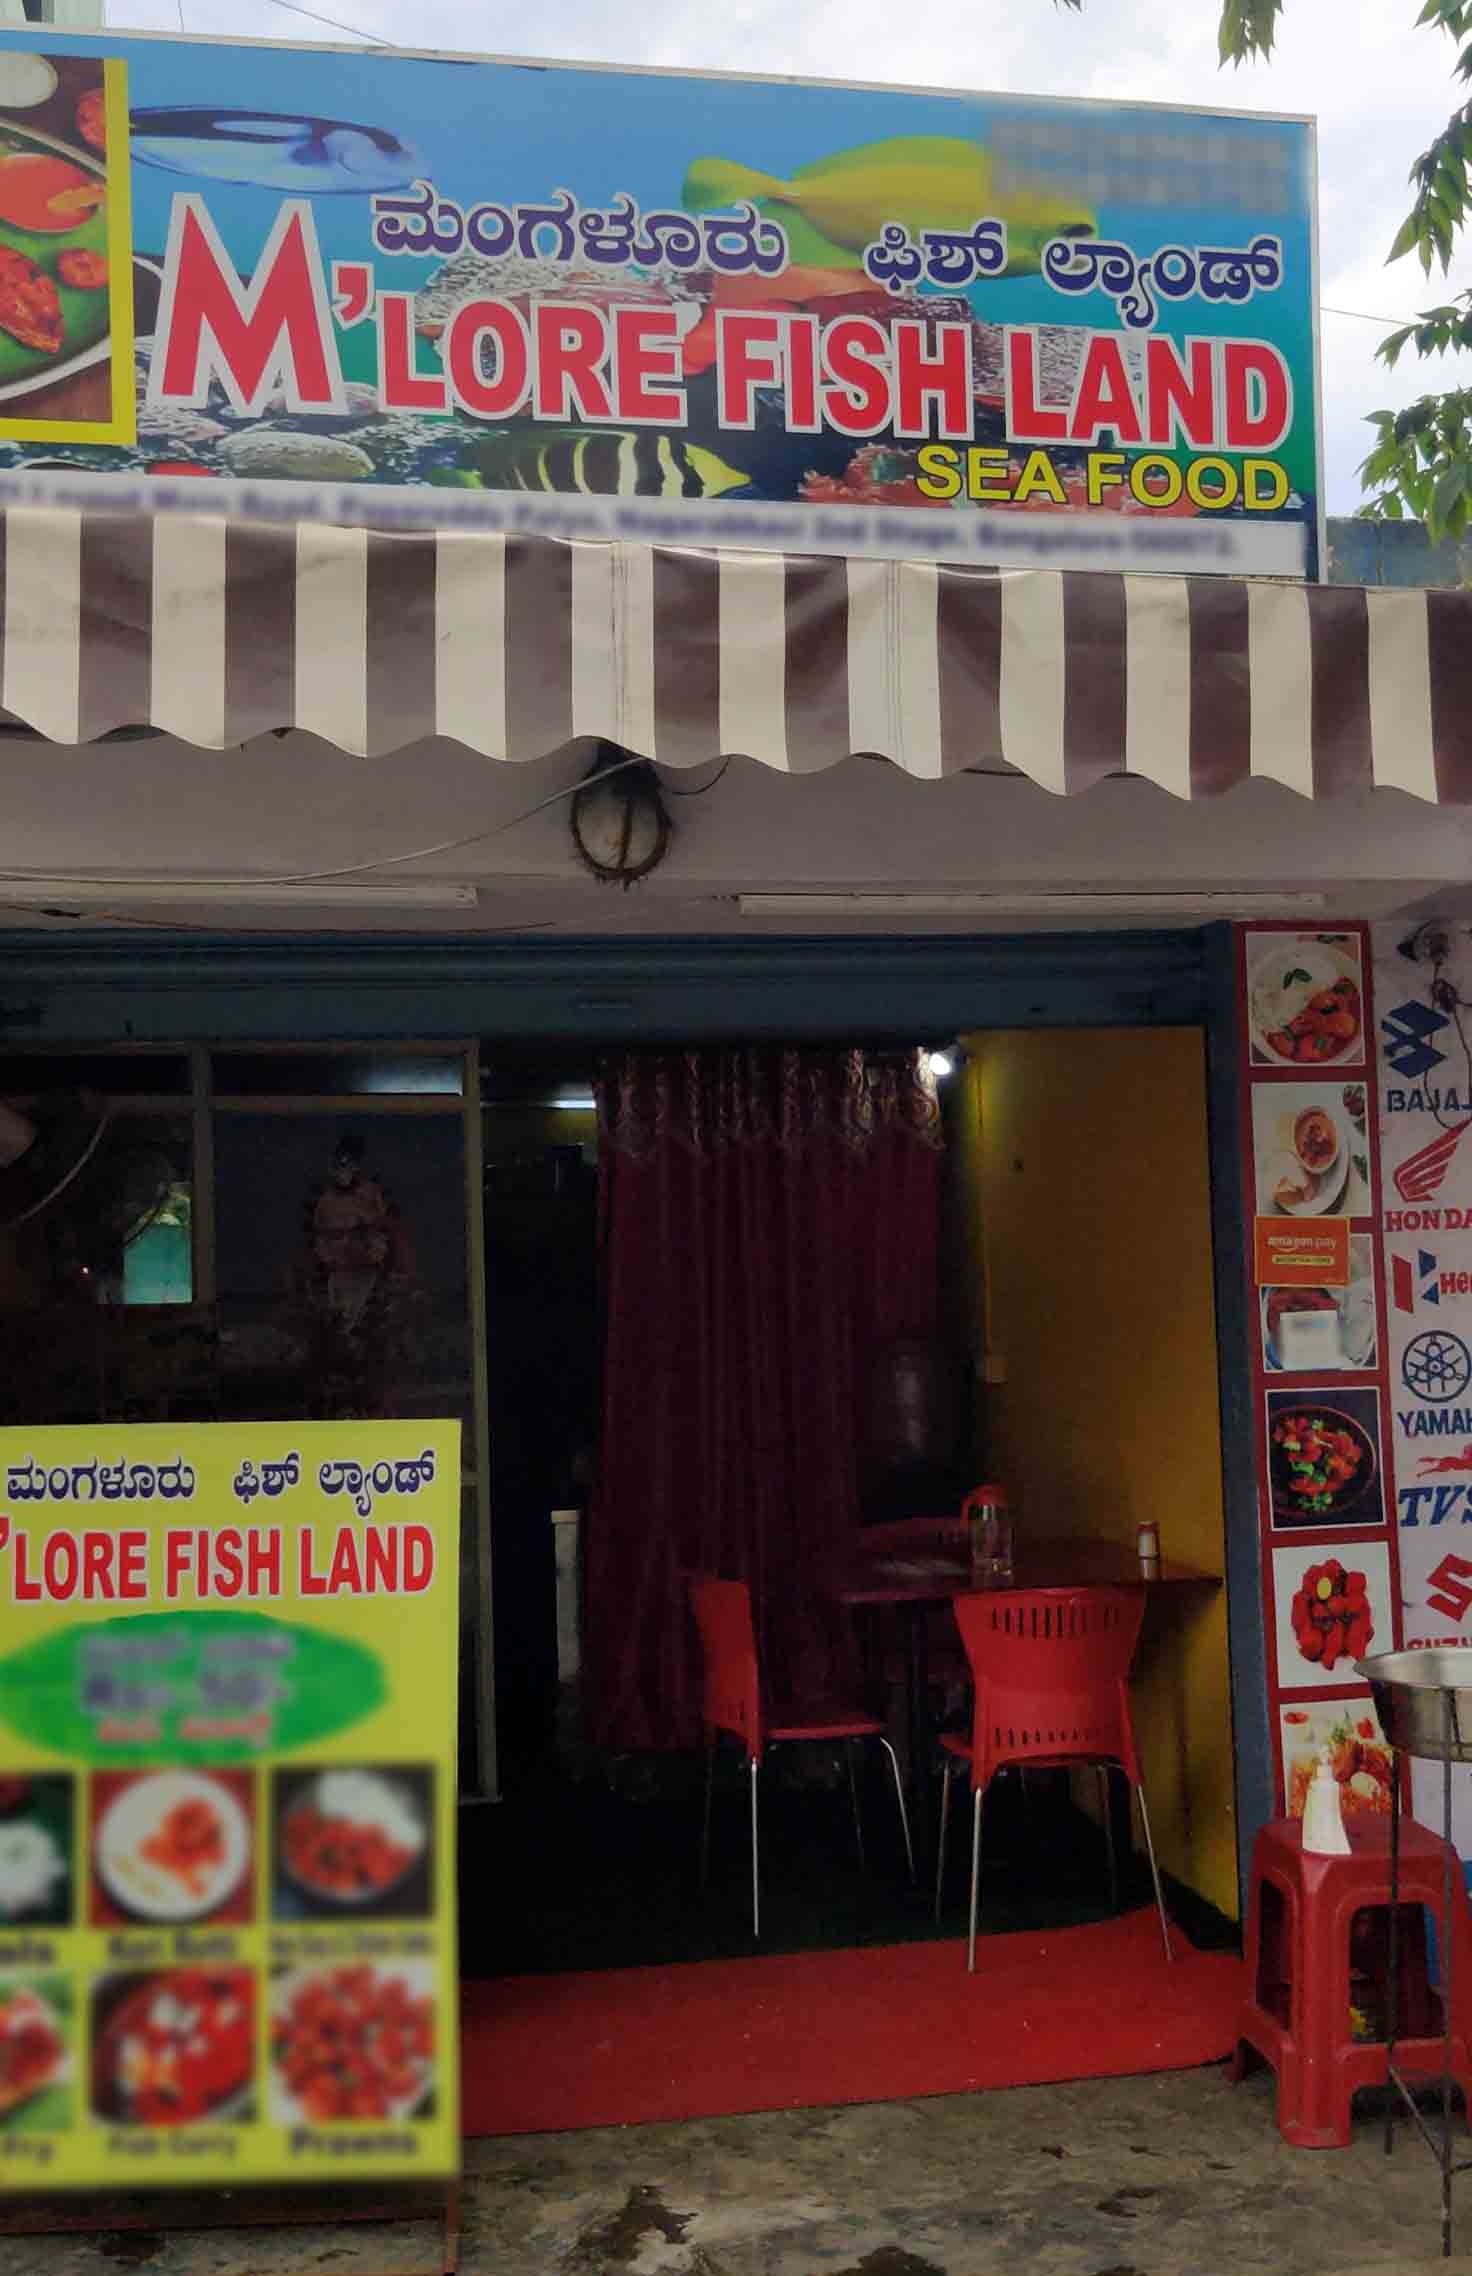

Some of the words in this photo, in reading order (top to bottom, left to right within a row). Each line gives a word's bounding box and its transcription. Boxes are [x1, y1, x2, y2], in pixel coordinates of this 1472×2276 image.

[373, 180, 787, 275] ಮಂಗಳೂರು
[159, 203, 690, 420] M'LORE
[718, 315, 972, 436] FISH
[1007, 331, 1290, 448] LAND
[916, 445, 1068, 504] SEA
[1087, 453, 1290, 512] FOOD
[167, 1529, 281, 1598] FISH
[300, 1525, 433, 1595] LAND
